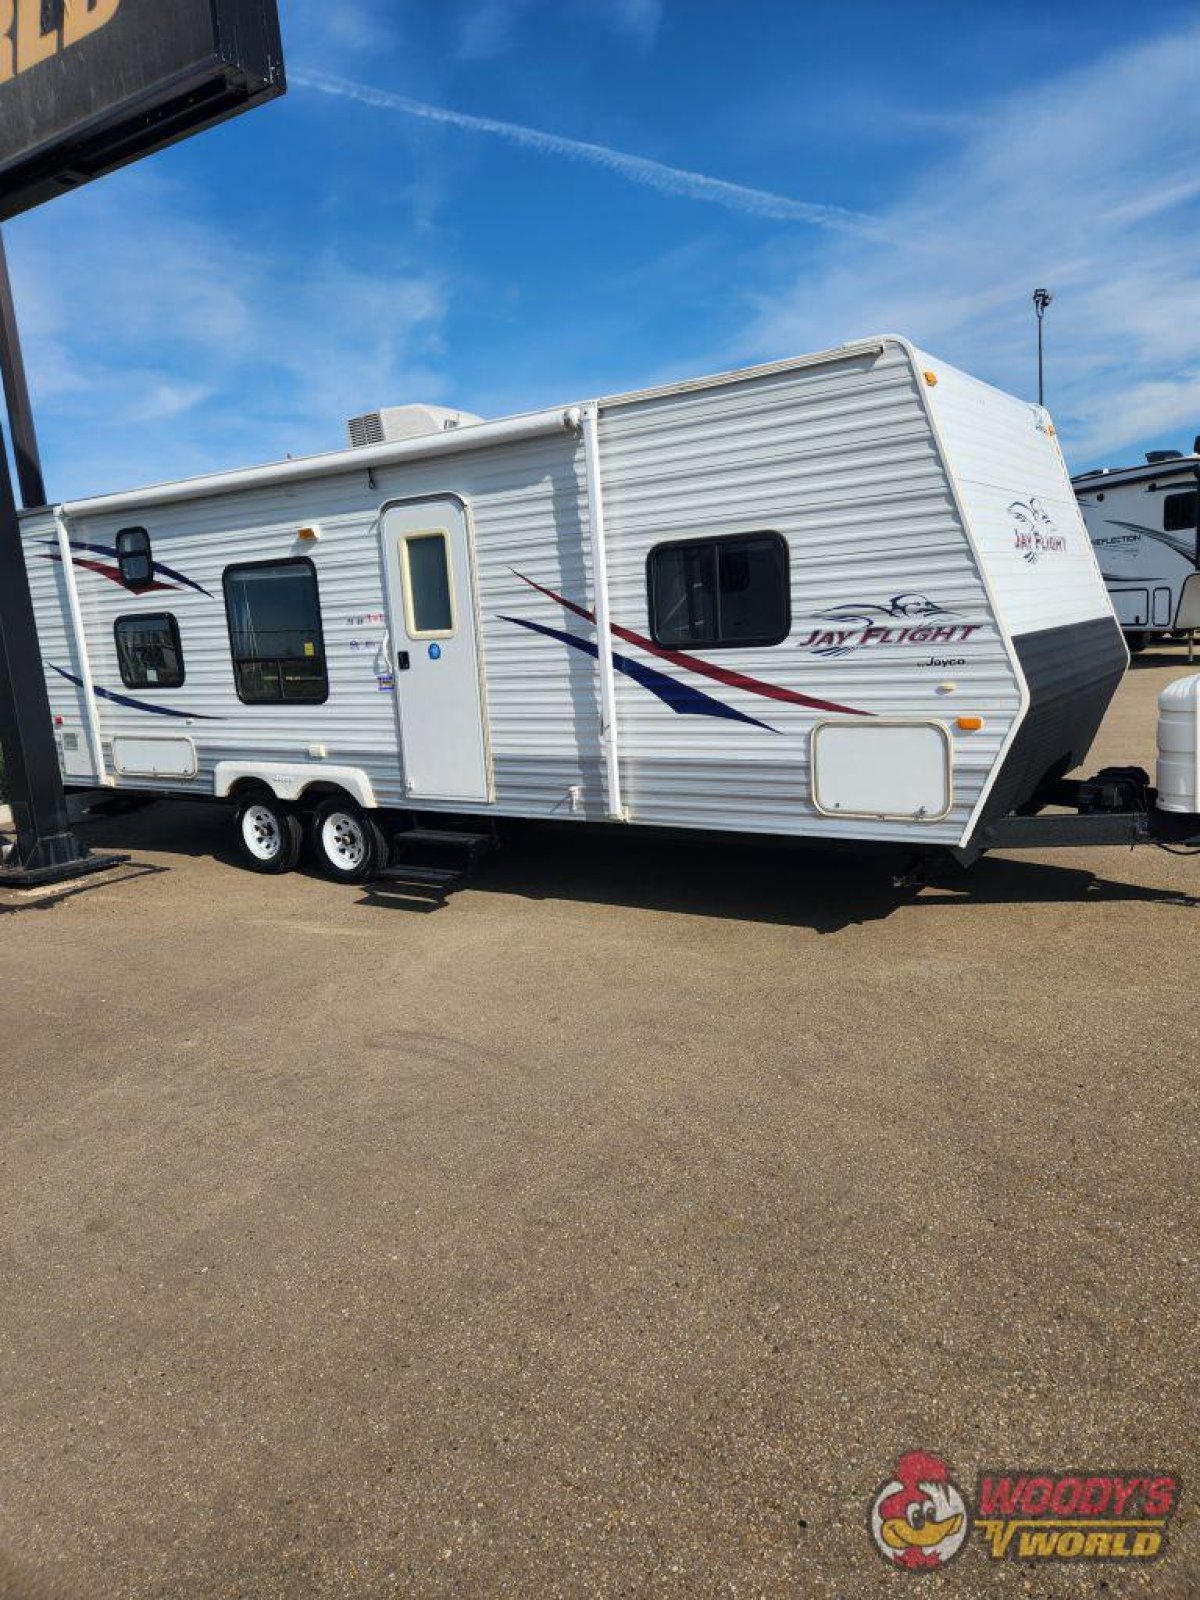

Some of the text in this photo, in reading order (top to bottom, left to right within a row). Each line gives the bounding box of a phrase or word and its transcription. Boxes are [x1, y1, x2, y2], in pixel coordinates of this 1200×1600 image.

[1033, 532, 1066, 551] FLIGHT
[798, 625, 983, 648] JAY FLIGHT
[926, 657, 966, 668] Jayco
